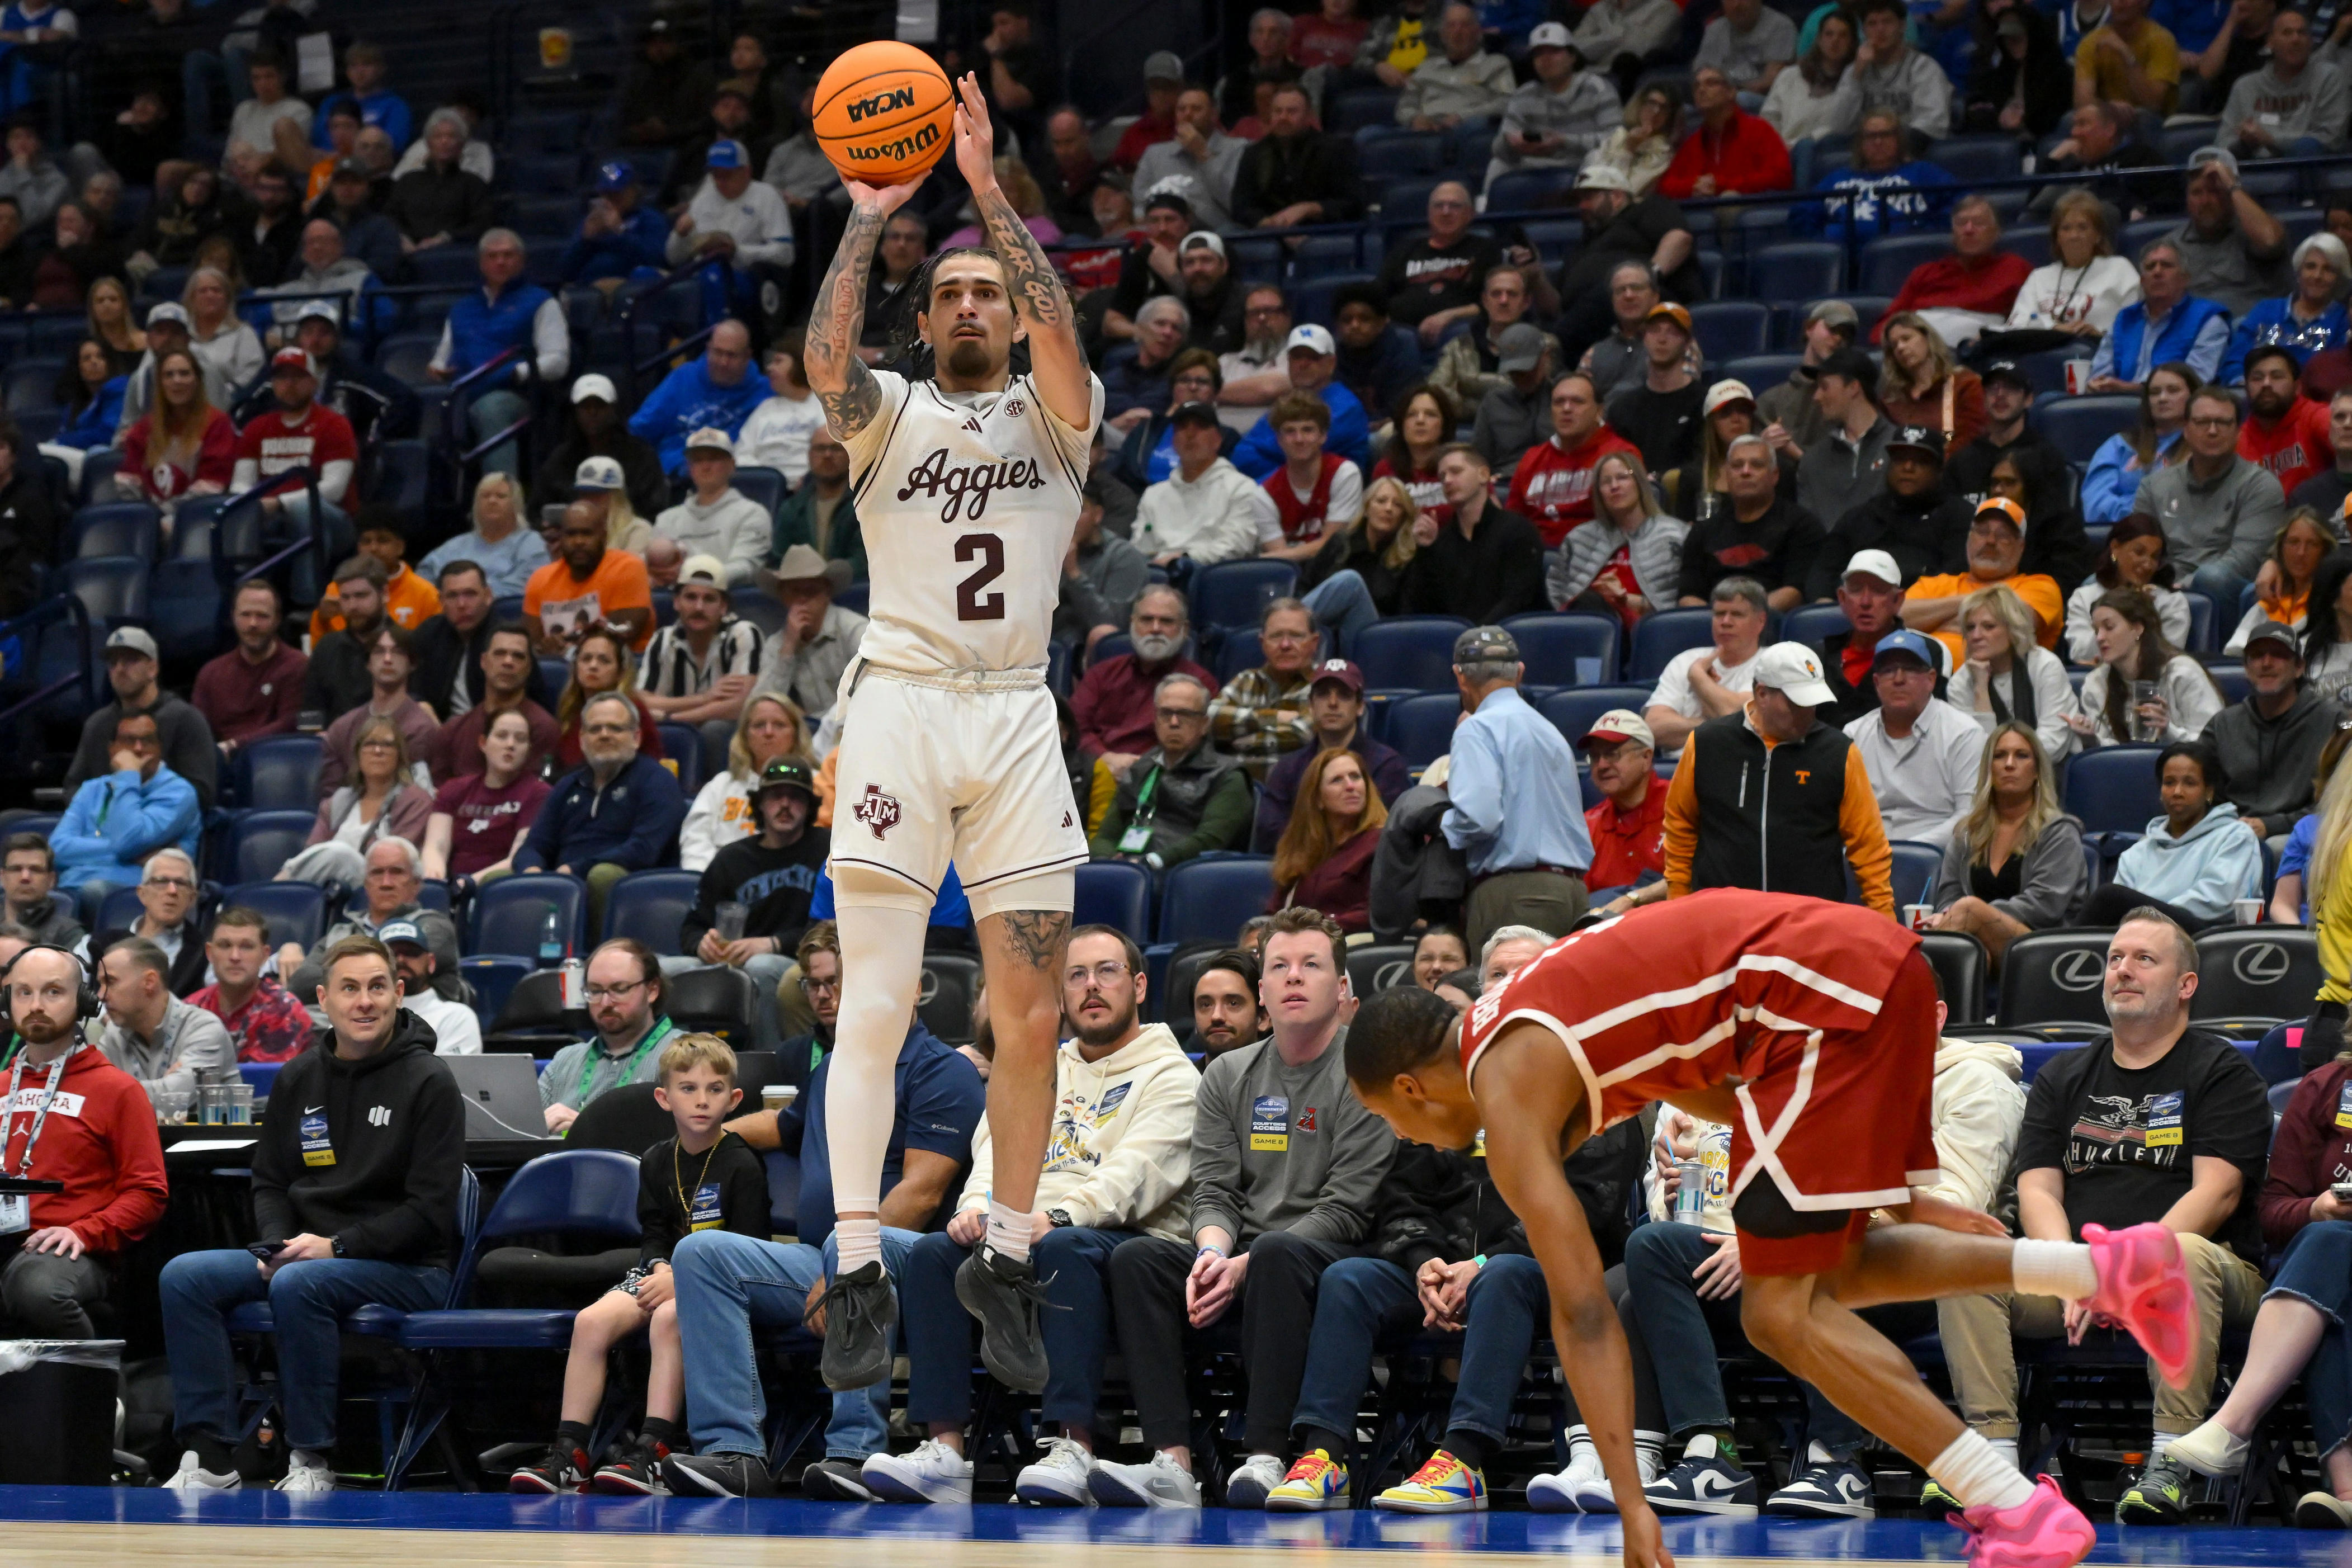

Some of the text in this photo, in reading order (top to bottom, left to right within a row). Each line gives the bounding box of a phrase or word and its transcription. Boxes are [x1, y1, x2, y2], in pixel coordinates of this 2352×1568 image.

[847, 86, 914, 122] NCAA
[846, 123, 941, 161] Wilson
[989, 214, 1061, 327] FEAR GOD
[1006, 400, 1024, 417] SEC
[897, 448, 1046, 523] Aggies
[954, 533, 1005, 621] 2
[395, 606, 414, 625] T
[1795, 770, 1811, 785] T
[1472, 968, 1517, 1037] BRO
[2148, 1119, 2181, 1127] ACCESS
[2071, 1142, 2164, 1164] HURLEY
[692, 1212, 721, 1221] ACCESS
